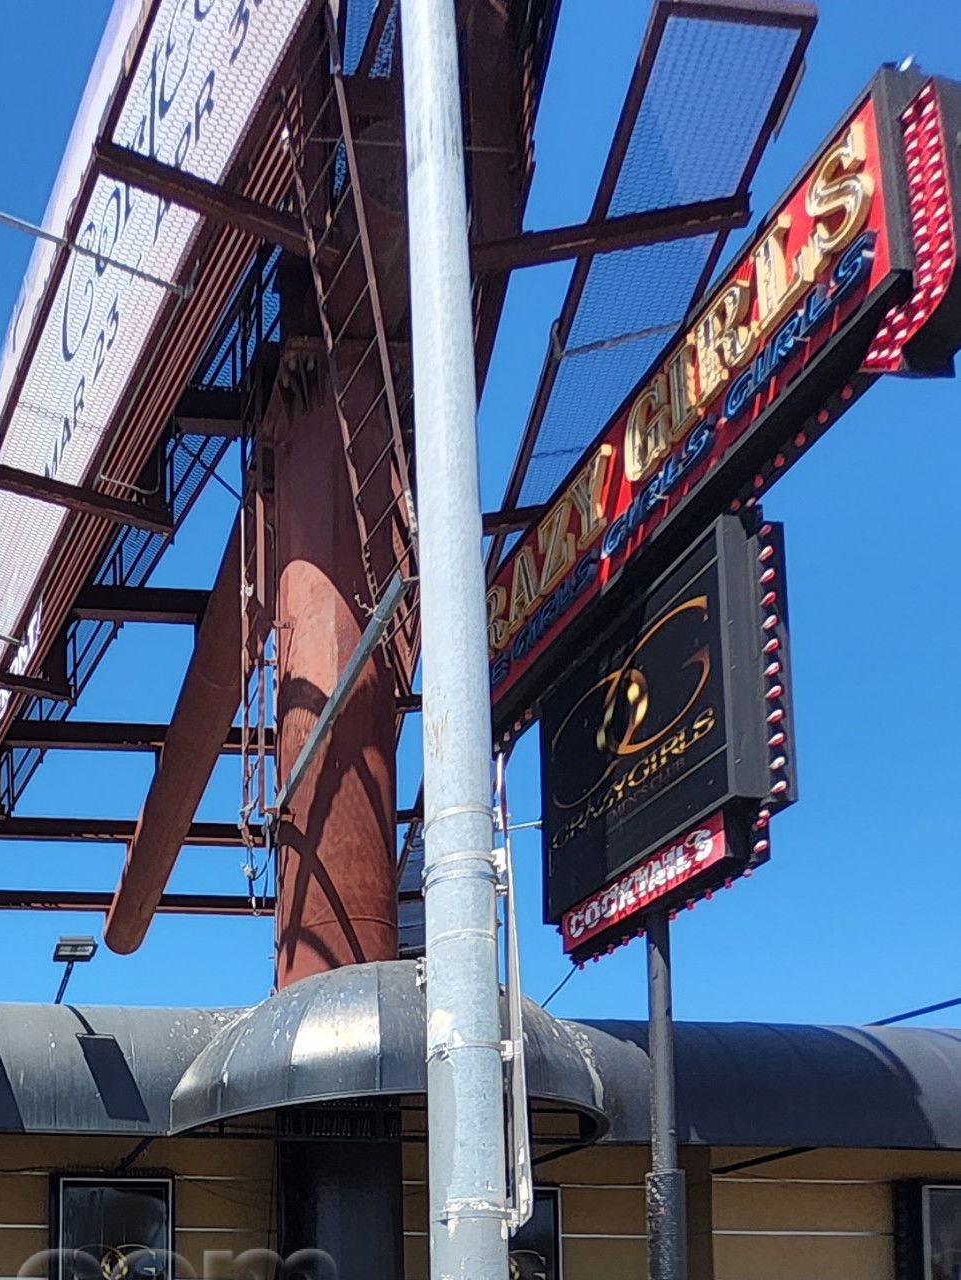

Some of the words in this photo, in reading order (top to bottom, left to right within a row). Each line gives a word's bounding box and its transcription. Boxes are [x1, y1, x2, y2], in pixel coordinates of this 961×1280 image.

[487, 443, 613, 650] RAZY
[624, 121, 875, 483] GIRLS
[601, 415, 718, 560] GIRLS
[723, 231, 878, 421] GIRLS
